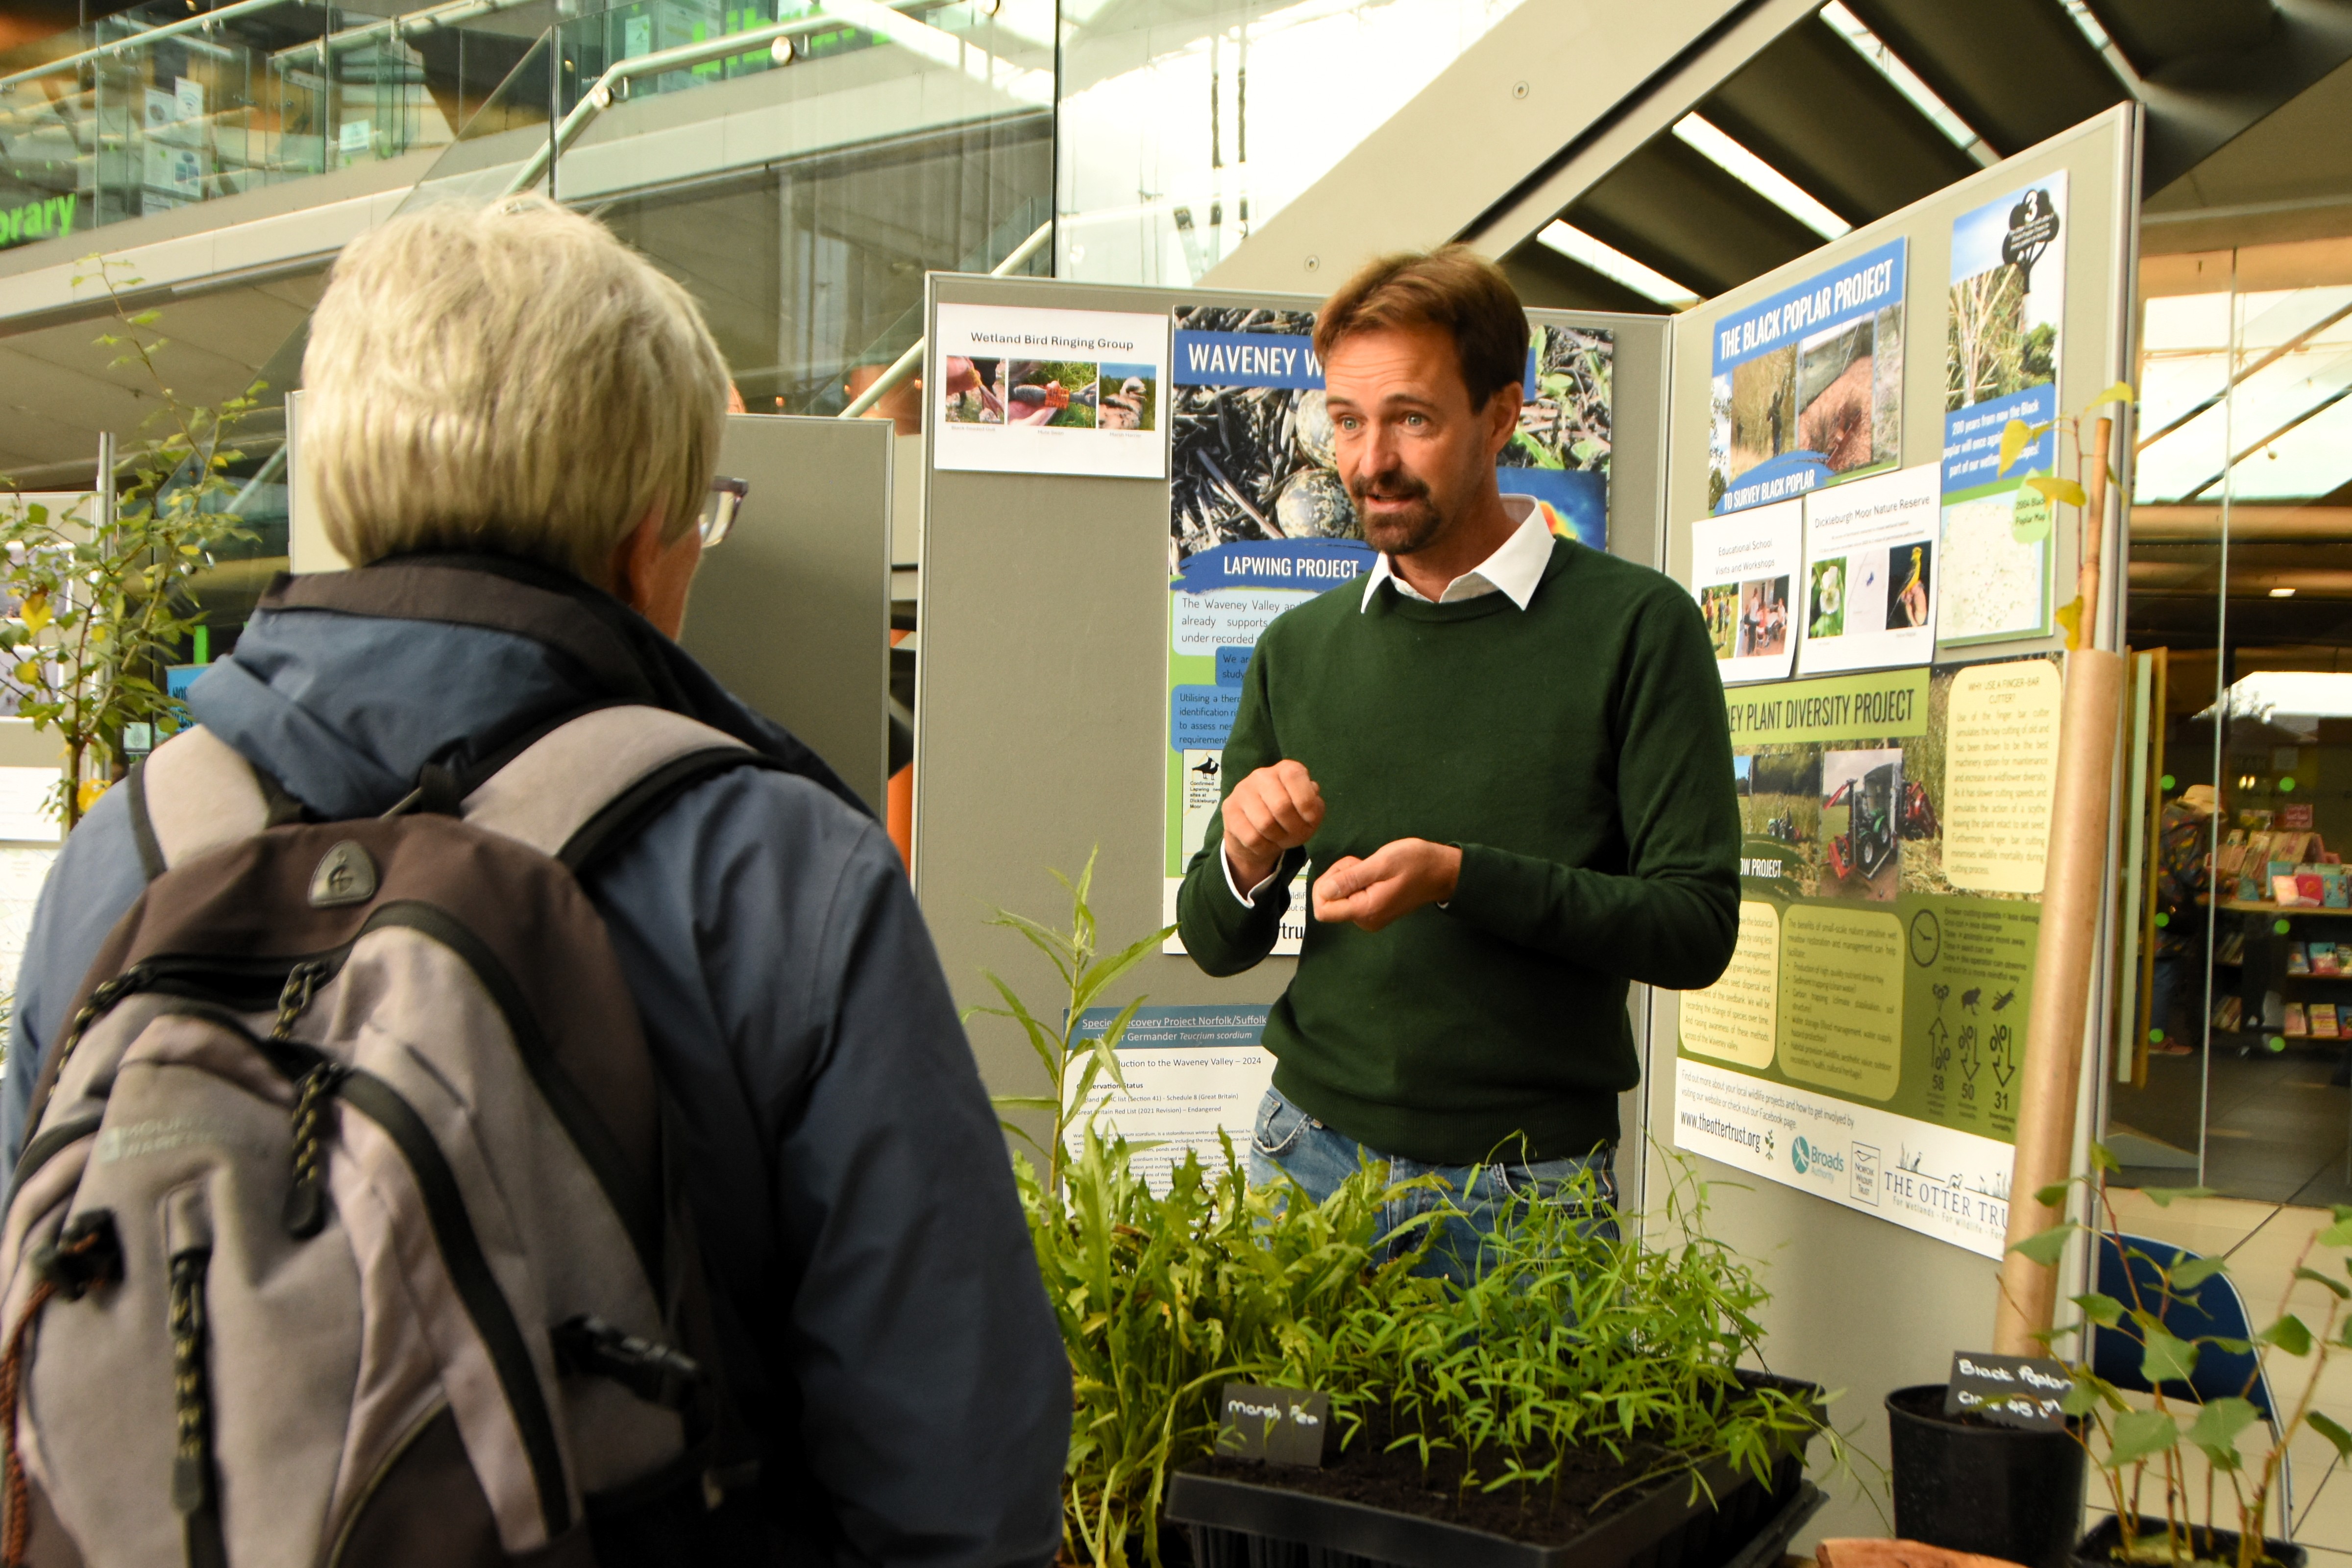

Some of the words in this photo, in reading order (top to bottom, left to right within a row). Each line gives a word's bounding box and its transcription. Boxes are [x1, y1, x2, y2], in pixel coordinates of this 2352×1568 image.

[2024, 191, 2037, 221] 3
[1720, 325, 1741, 360] THE
[1742, 308, 1781, 352] BLACK
[1783, 286, 1832, 335] POPLAR
[1834, 259, 1893, 314] PROJECT
[971, 332, 1021, 344] Wetland
[1025, 335, 1048, 345] Bird
[1051, 336, 1094, 349] Ringing
[1098, 338, 1133, 351] Group
[1188, 343, 1297, 376] WAVENEY
[1965, 419, 1981, 434] years
[1981, 415, 1996, 426] from
[1996, 411, 2009, 422] now
[2009, 406, 2020, 418] the
[2021, 399, 2039, 415] Black
[1961, 439, 1972, 453] will
[1972, 438, 1987, 450] once
[1949, 463, 1961, 479] part
[1962, 460, 1969, 473] of
[1969, 460, 1979, 471] our
[1724, 492, 1733, 510] TO
[1734, 484, 1761, 508] SURVEY
[1762, 477, 1785, 500] BLACK
[1786, 469, 1815, 493] POPLAR
[1815, 511, 1853, 528] Dickleburgh
[1855, 508, 1872, 519] Moor
[1874, 503, 1898, 514] Nature
[1899, 496, 1930, 509] Reserve
[1718, 541, 1751, 556] Educational
[1752, 538, 1772, 550] School
[1224, 556, 1291, 576] LAPWING
[1297, 558, 1359, 578] PROJECT
[1715, 566, 1730, 575] Visits
[1731, 563, 1741, 573] and
[1743, 559, 1775, 570] Workshops
[1182, 598, 1200, 609] The
[1204, 598, 1247, 612] Waveney
[1252, 600, 1279, 613] Valley
[1181, 615, 1216, 629] already
[1227, 618, 1268, 629] supports
[1181, 632, 1209, 643] under
[1212, 634, 1253, 644] recorded
[1223, 654, 1237, 664] We
[1223, 669, 1245, 681] study
[1985, 680, 1996, 690] USE
[1180, 693, 1209, 704] Utilising
[1179, 707, 1229, 716] identification
[1747, 701, 1783, 731] PLANT
[1786, 695, 1850, 729] DIVERSITY
[1854, 688, 1914, 724] PROJECT
[1179, 721, 1187, 729] to
[1752, 858, 1782, 878] PROJECT
[1082, 1019, 1112, 1028] Specie
[1127, 1019, 1162, 1028] ecovery
[1164, 1017, 1196, 1028] Project
[1199, 1015, 1267, 1025] Norfolk/Suffolk
[1127, 1032, 1177, 1041] Germander
[1174, 1058, 1209, 1067] Waveney
[1211, 1057, 1233, 1066] Valley
[1933, 1074, 1944, 1091] 58
[1961, 1082, 1974, 1100] 50
[1682, 1070, 1691, 1081] Find
[1700, 1076, 1711, 1087] more
[1712, 1077, 1725, 1091] about
[1725, 1083, 1736, 1094] your
[1737, 1083, 1748, 1096] local
[1748, 1087, 1765, 1102] wildlife
[1765, 1094, 1785, 1108] projects
[1786, 1099, 1795, 1110] and
[1796, 1100, 1807, 1113] how
[1808, 1104, 1813, 1116] to
[1814, 1107, 1823, 1120] get
[1824, 1110, 1846, 1125] involved
[1847, 1115, 1854, 1129] by
[1682, 1087, 1696, 1101] visiting
[1705, 1094, 1721, 1106] website
[1728, 1100, 1741, 1112] check
[1760, 1107, 1783, 1124] Facebook
[1994, 1091, 2008, 1111] 31
[1681, 1110, 1761, 1153] www.theottertrust.org
[1812, 1146, 1844, 1172] Broads
[1855, 1161, 1874, 1176] NORFOLK
[1858, 1182, 1870, 1196] TRUST
[1885, 1171, 1913, 1198] THE
[1919, 1183, 1971, 1218] OTTER
[1959, 1358, 2014, 1382] Black
[2017, 1365, 2074, 1390] Poplar
